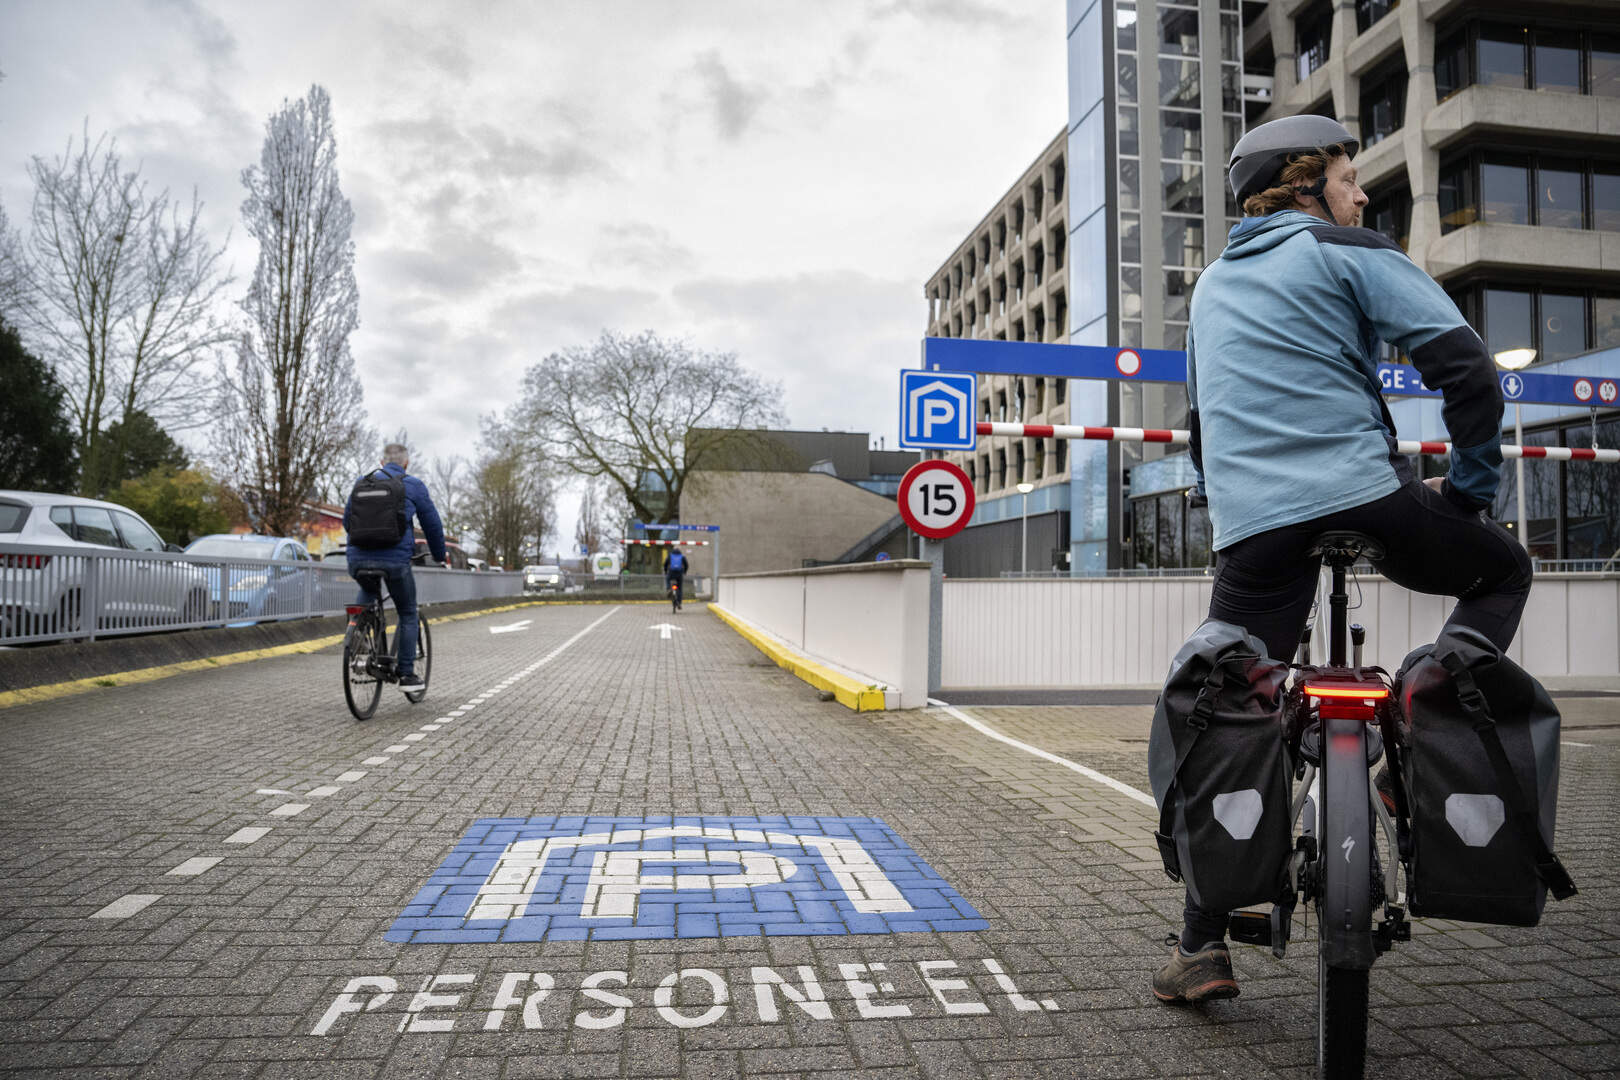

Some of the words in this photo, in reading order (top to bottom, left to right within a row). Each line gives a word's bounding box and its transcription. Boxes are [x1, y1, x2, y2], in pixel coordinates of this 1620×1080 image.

[923, 398, 955, 438] P
[919, 483, 957, 516] 15
[580, 850, 798, 919] P
[309, 958, 1061, 1036] PERSONEEL
